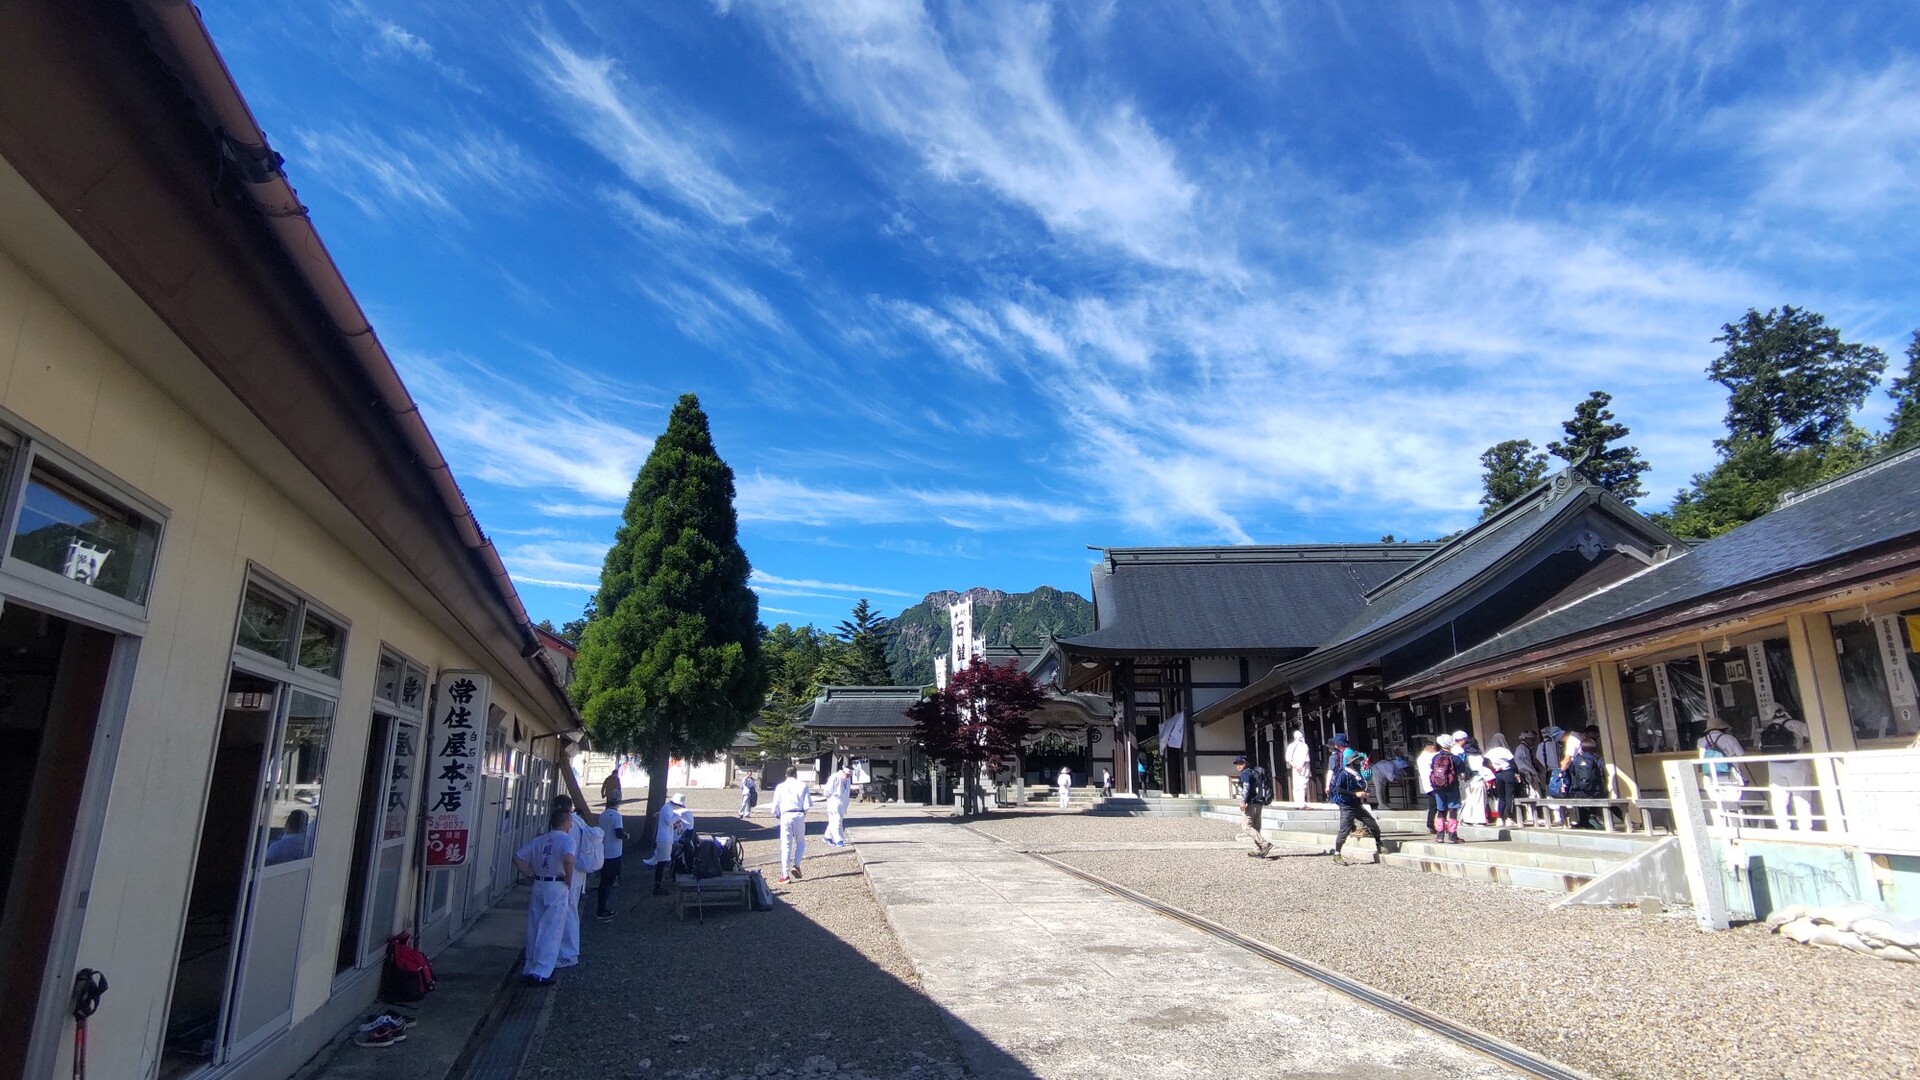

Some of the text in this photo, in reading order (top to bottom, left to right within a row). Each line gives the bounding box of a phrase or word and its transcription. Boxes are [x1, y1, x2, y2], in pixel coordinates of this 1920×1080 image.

[430, 678, 478, 812] 常住屋本店
[463, 731, 478, 792] 白石旅館
